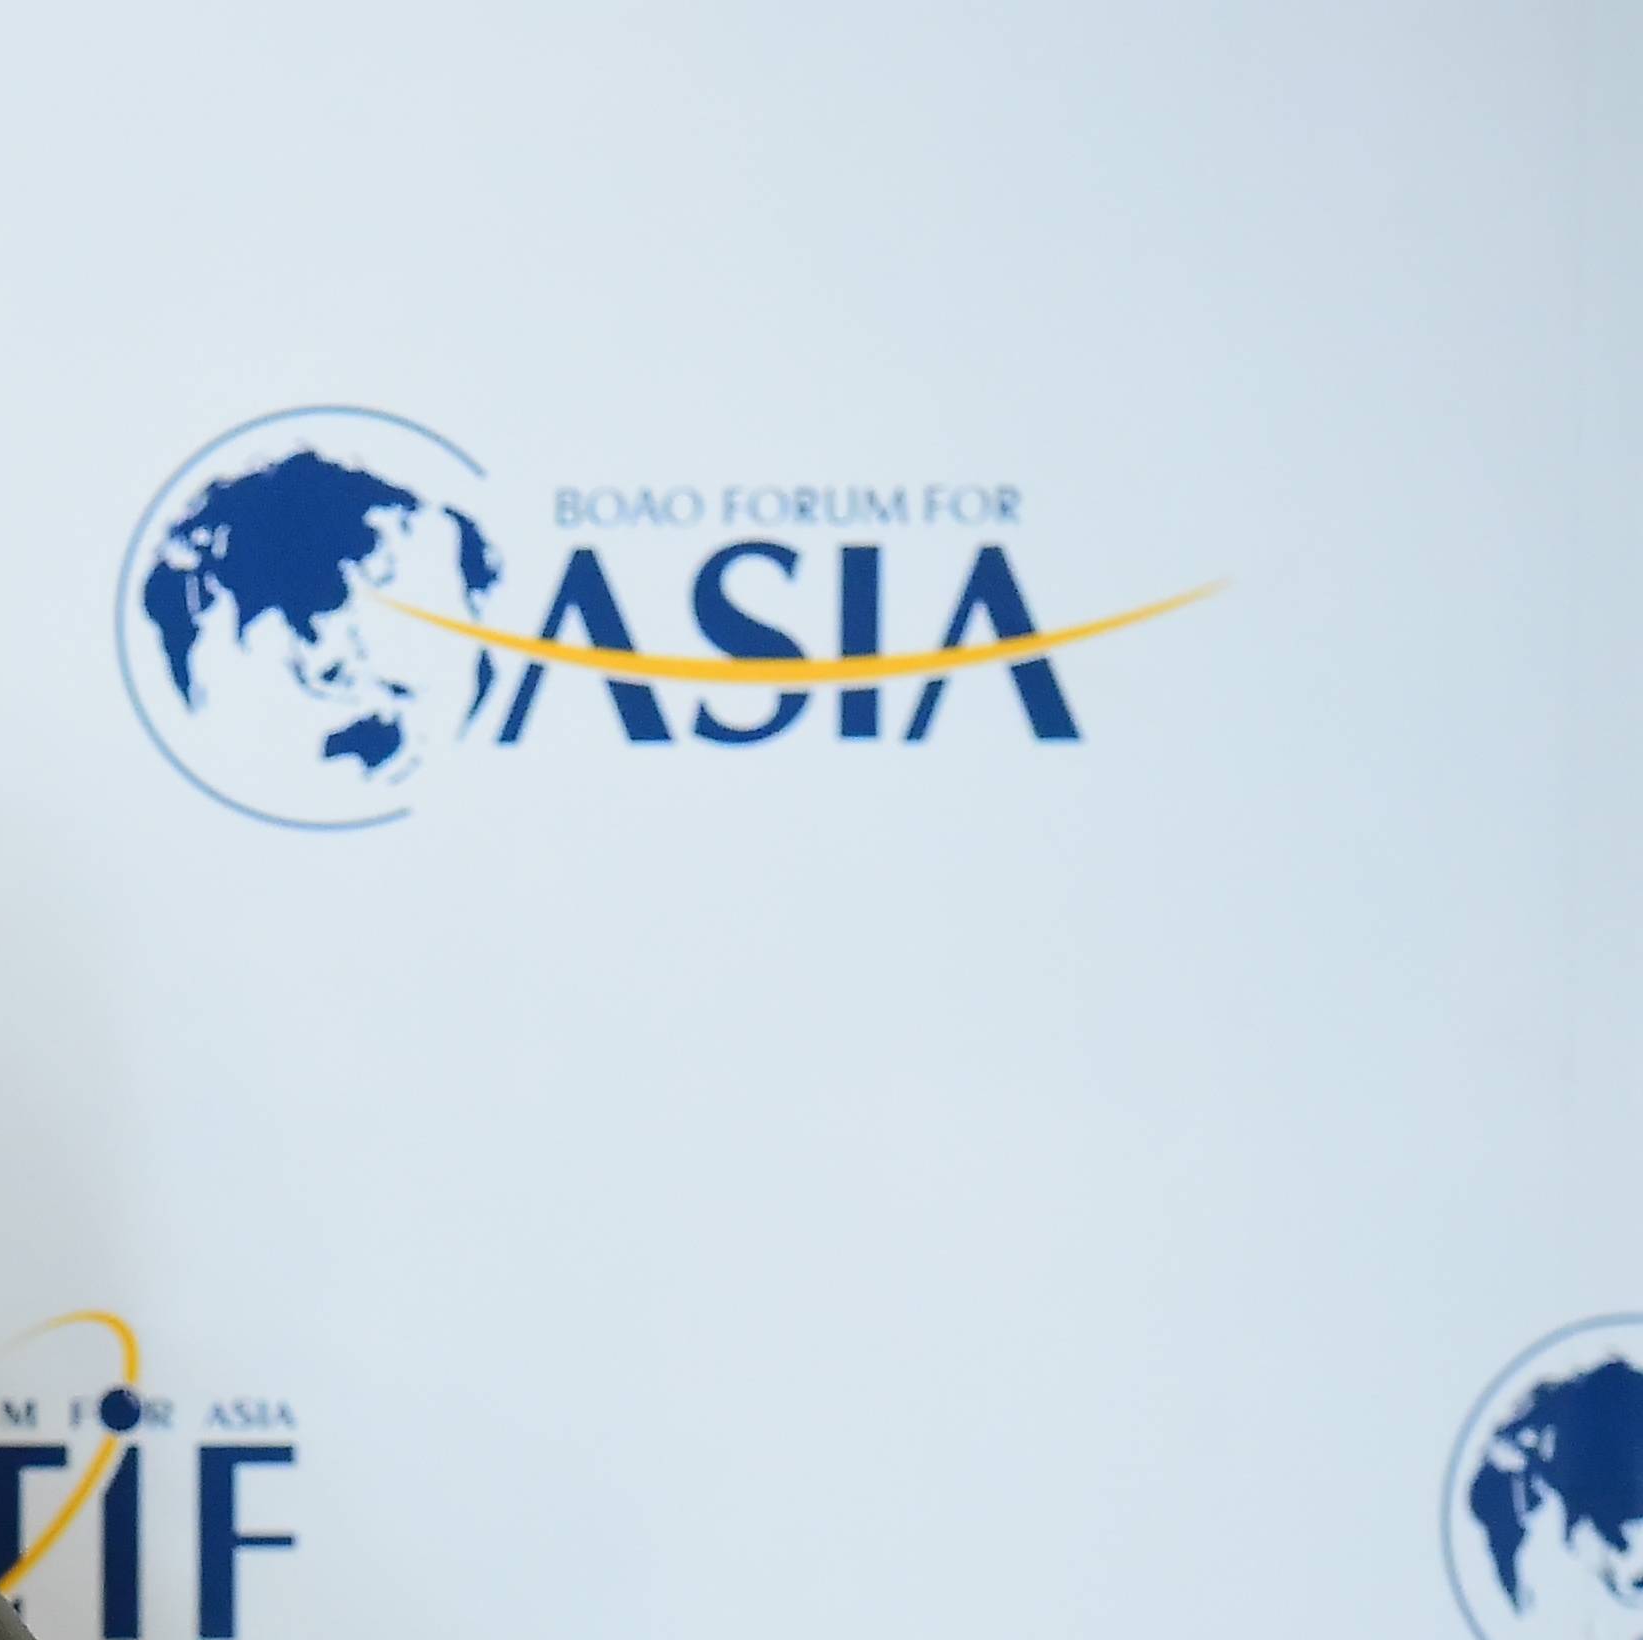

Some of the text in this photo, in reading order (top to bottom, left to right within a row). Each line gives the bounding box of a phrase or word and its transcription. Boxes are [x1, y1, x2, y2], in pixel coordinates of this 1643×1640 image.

[555, 487, 1023, 527] BOAO FORUM FOR
[499, 540, 1081, 744] ASIA
[70, 1399, 173, 1432] FR
[206, 1401, 297, 1431] ASIA
